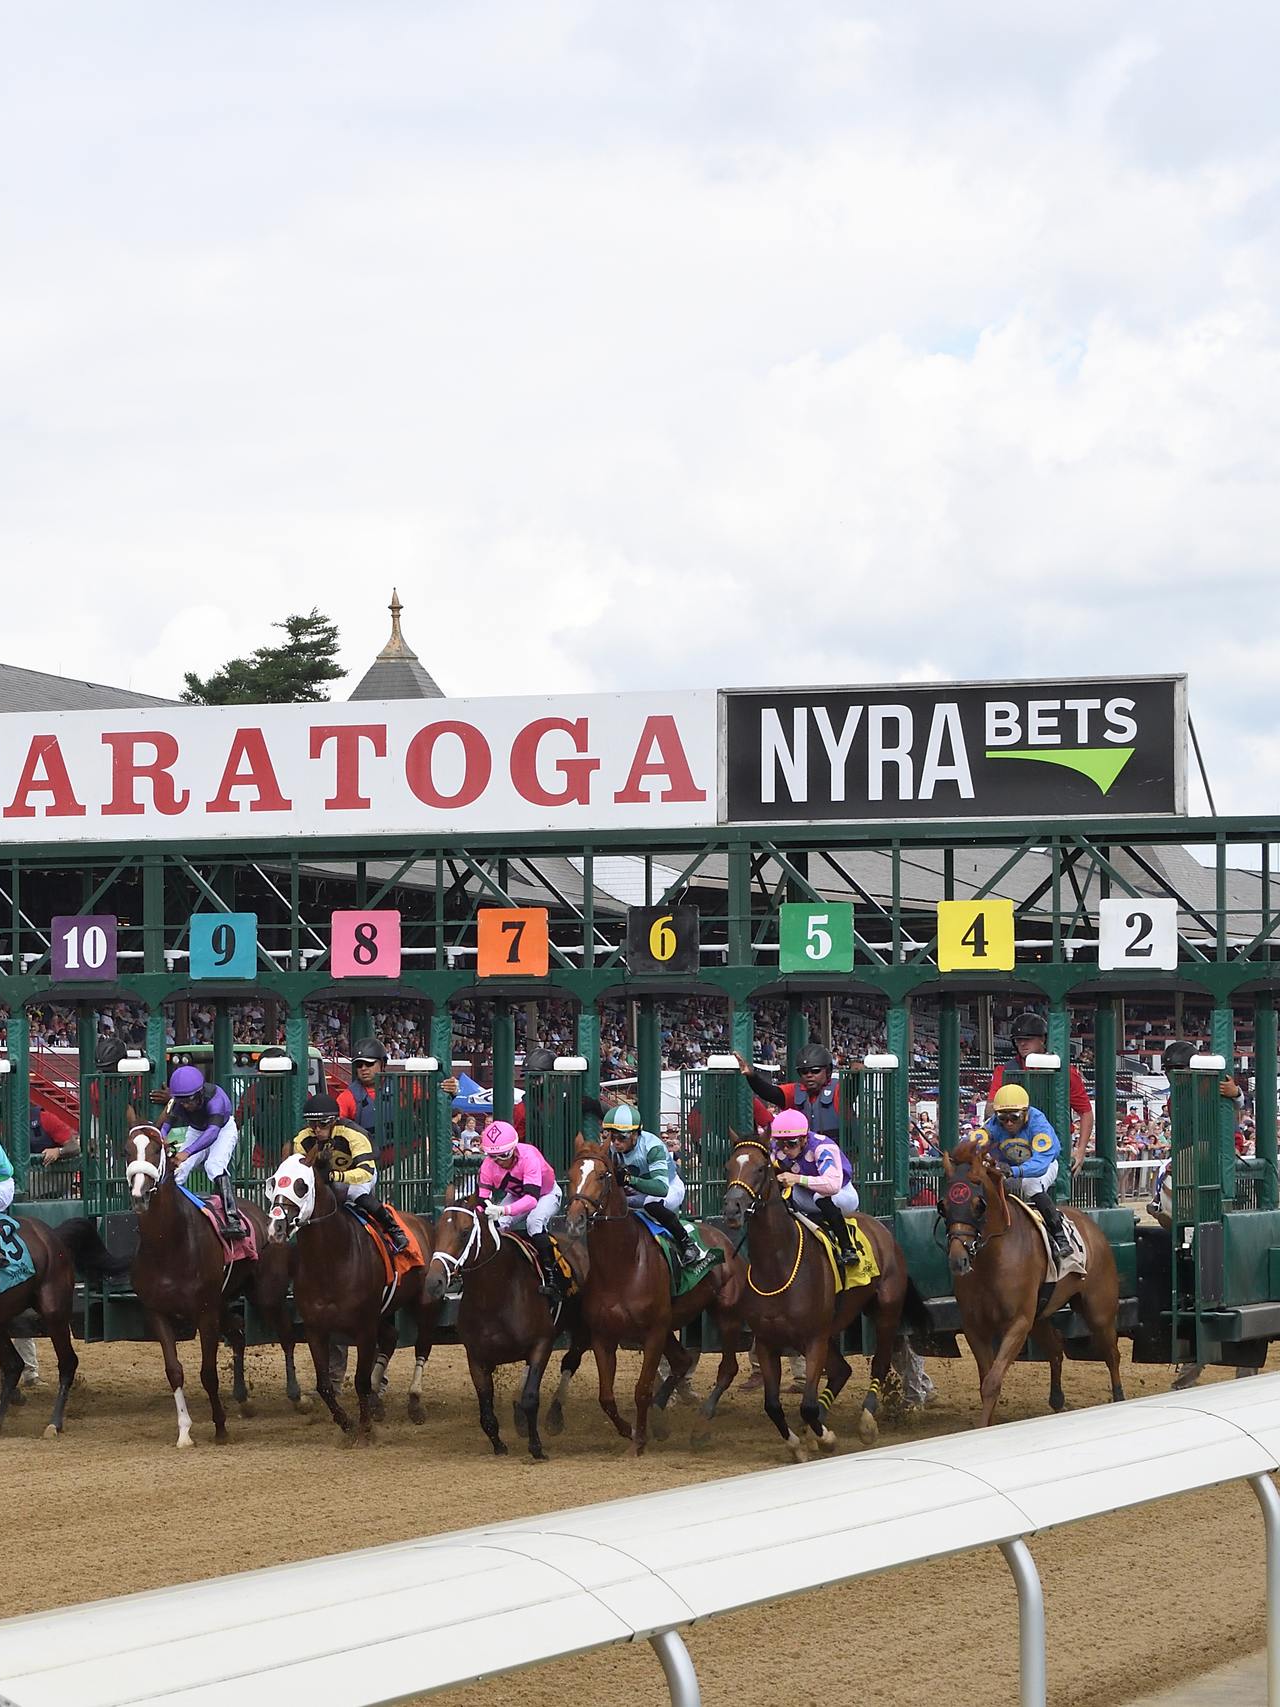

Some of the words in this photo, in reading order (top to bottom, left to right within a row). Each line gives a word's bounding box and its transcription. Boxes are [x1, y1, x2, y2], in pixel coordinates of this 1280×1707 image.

[762, 703, 975, 802] NYRA
[986, 698, 1137, 745] BETS
[63, 926, 108, 969] 10
[212, 923, 236, 966] 9
[353, 922, 379, 965] 8
[501, 920, 527, 963] 7
[649, 916, 677, 961] 6
[806, 914, 832, 960] 5
[961, 912, 989, 957] 4
[1125, 912, 1153, 957] 2
